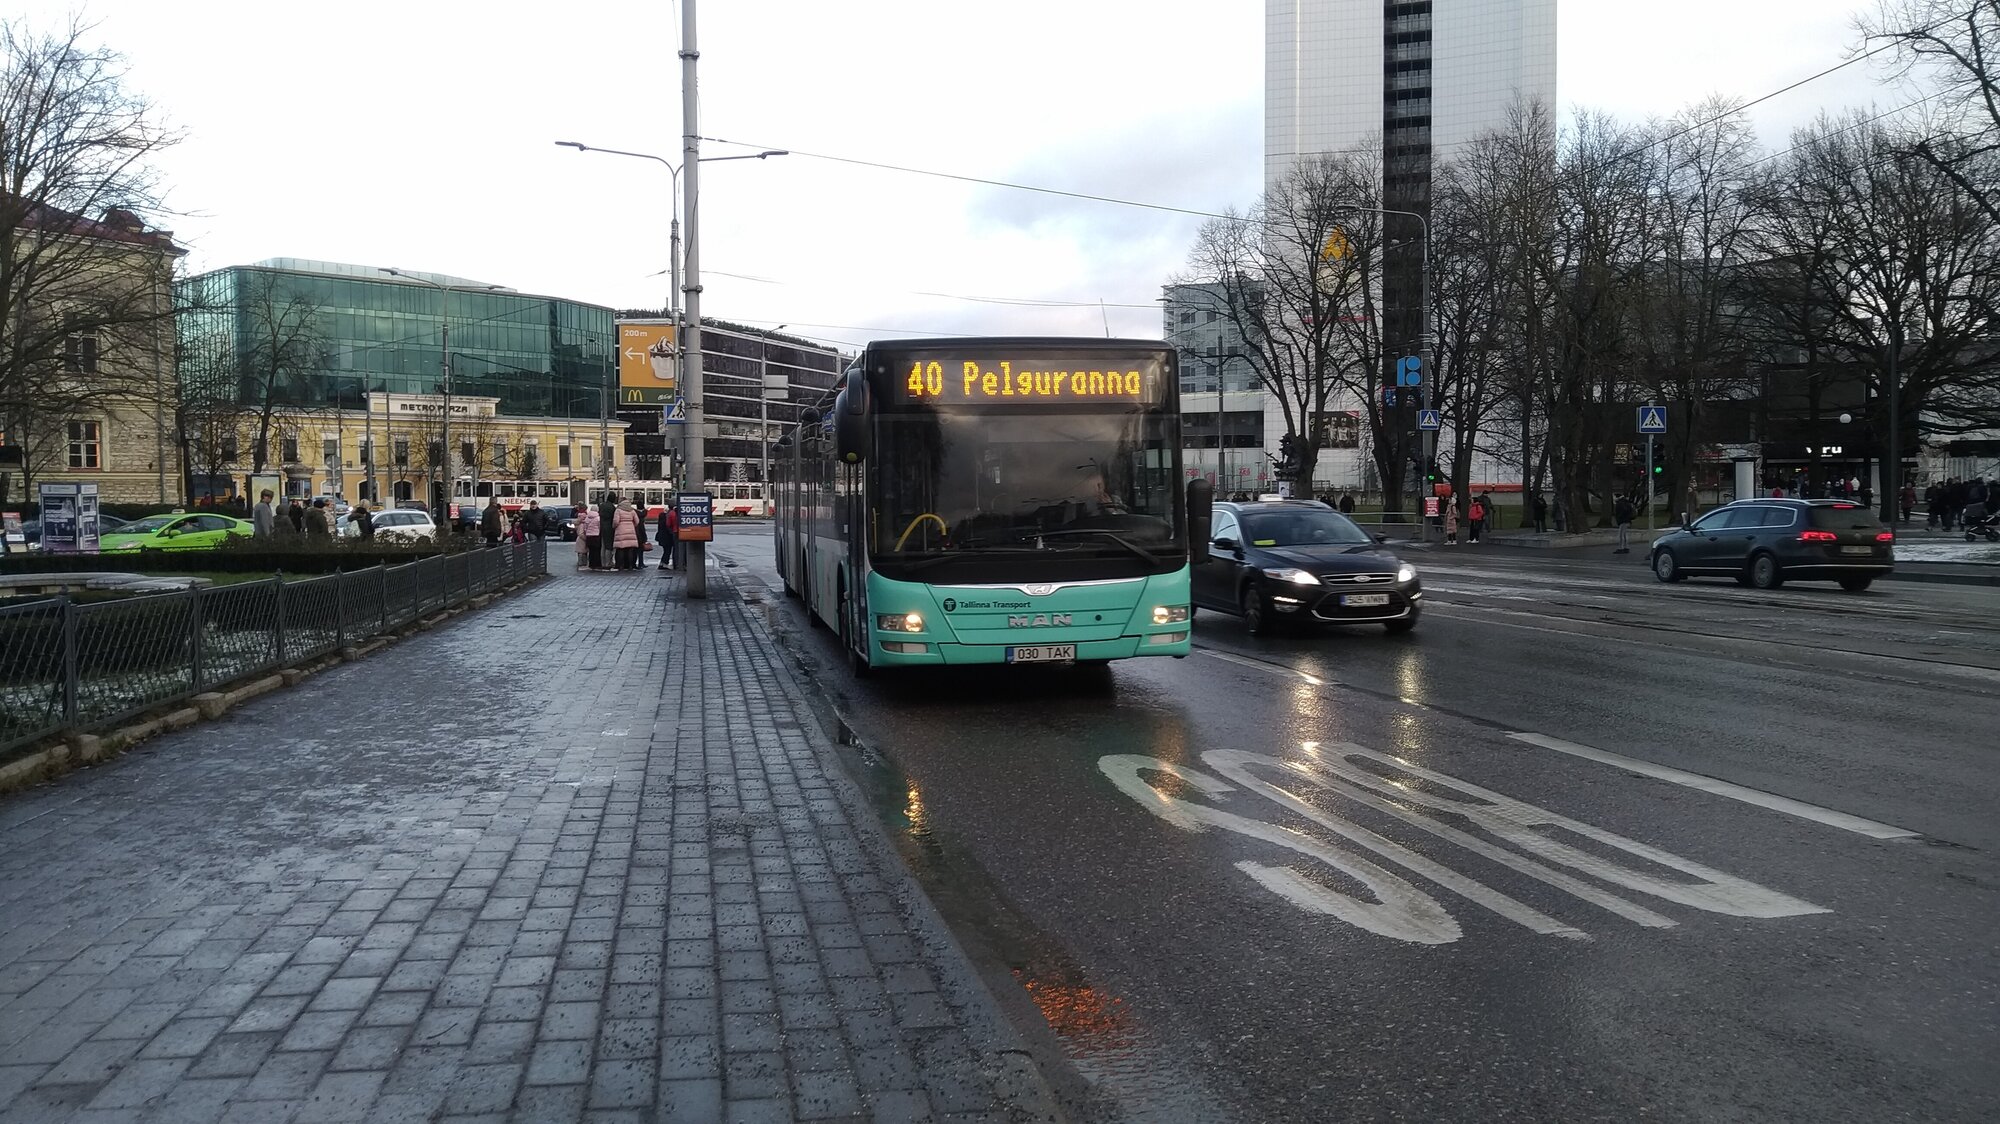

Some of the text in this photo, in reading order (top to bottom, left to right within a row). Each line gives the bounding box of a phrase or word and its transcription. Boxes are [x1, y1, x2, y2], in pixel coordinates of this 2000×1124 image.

[908, 361, 1141, 396] 40 Pelguranna
[400, 403, 468, 413] METRO PAZA
[680, 505, 702, 513] 3000
[680, 517, 702, 525] 3001
[959, 601, 1031, 609] Tallinna Transport
[1008, 613, 1072, 628] MAN
[1018, 647, 1071, 660] 030 TAK
